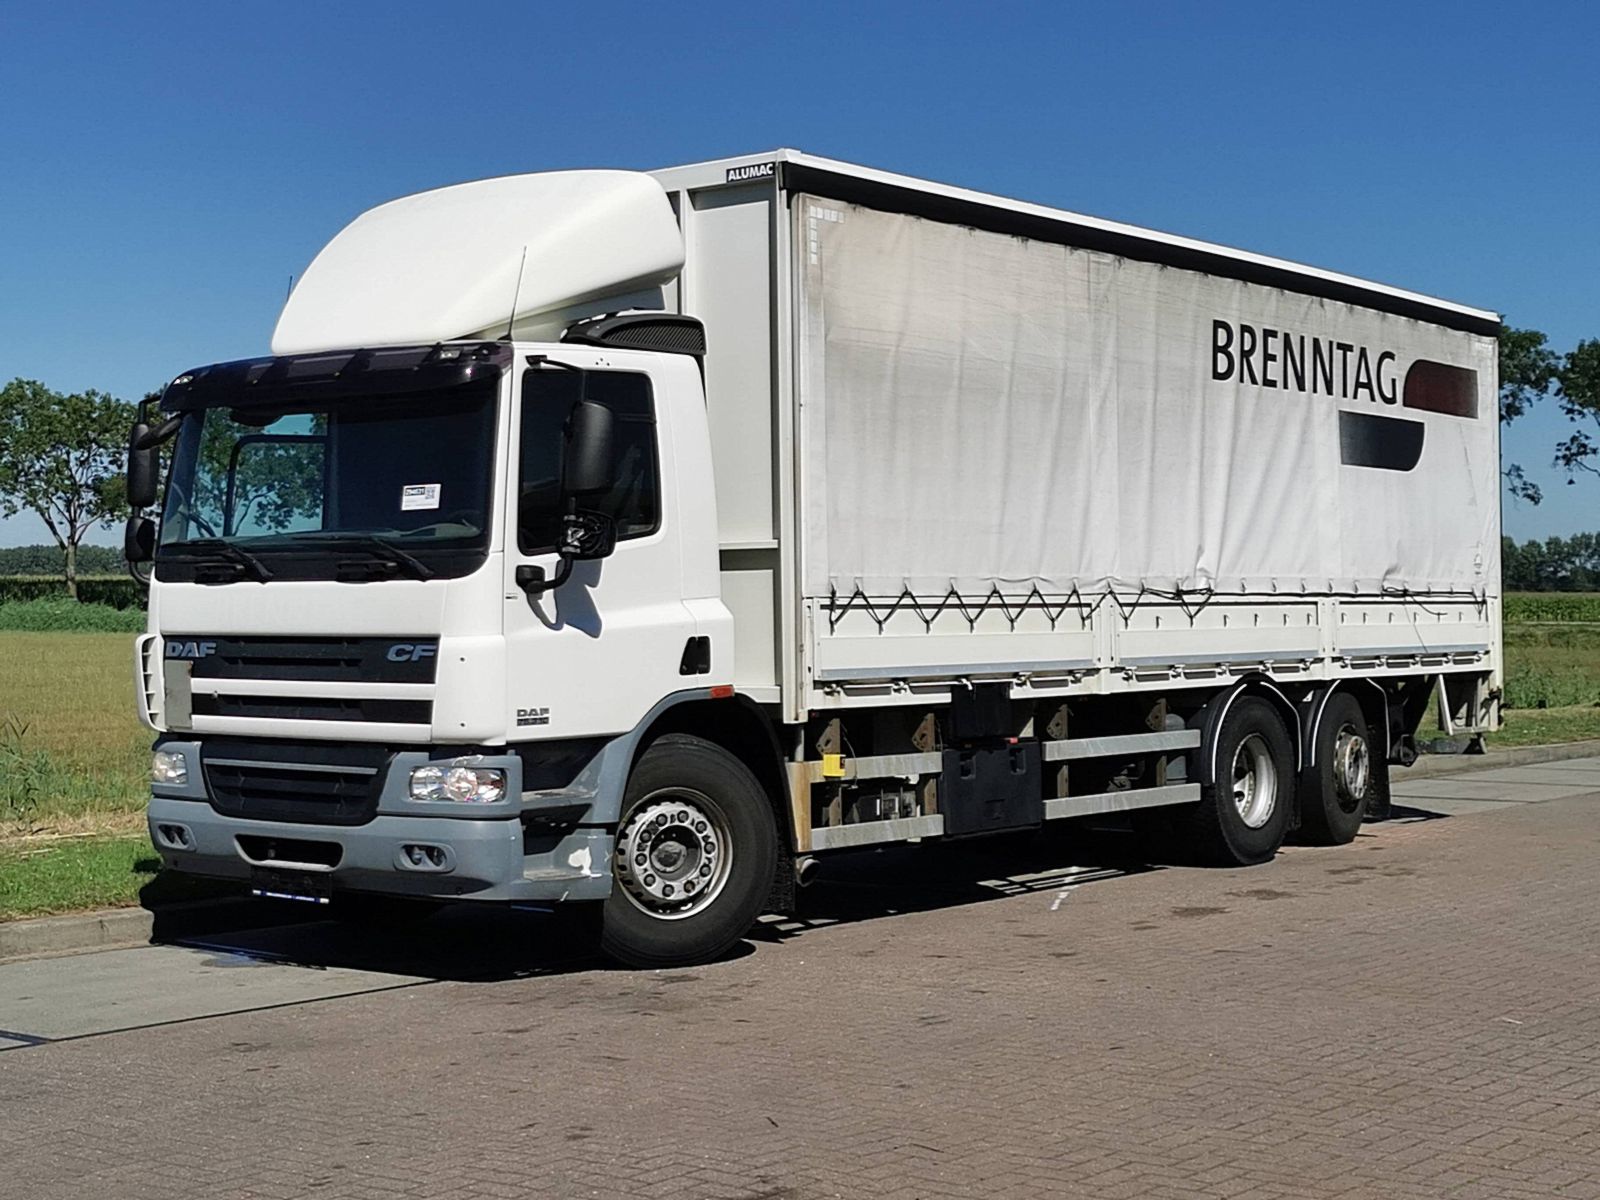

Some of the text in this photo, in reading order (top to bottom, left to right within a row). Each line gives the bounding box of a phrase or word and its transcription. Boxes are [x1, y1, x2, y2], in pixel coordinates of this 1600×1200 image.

[728, 163, 774, 181] ALUMAC
[1212, 319, 1397, 404] BRENNTAG
[165, 641, 216, 658] DAF
[386, 644, 437, 662] CF
[516, 707, 550, 718] DAF
